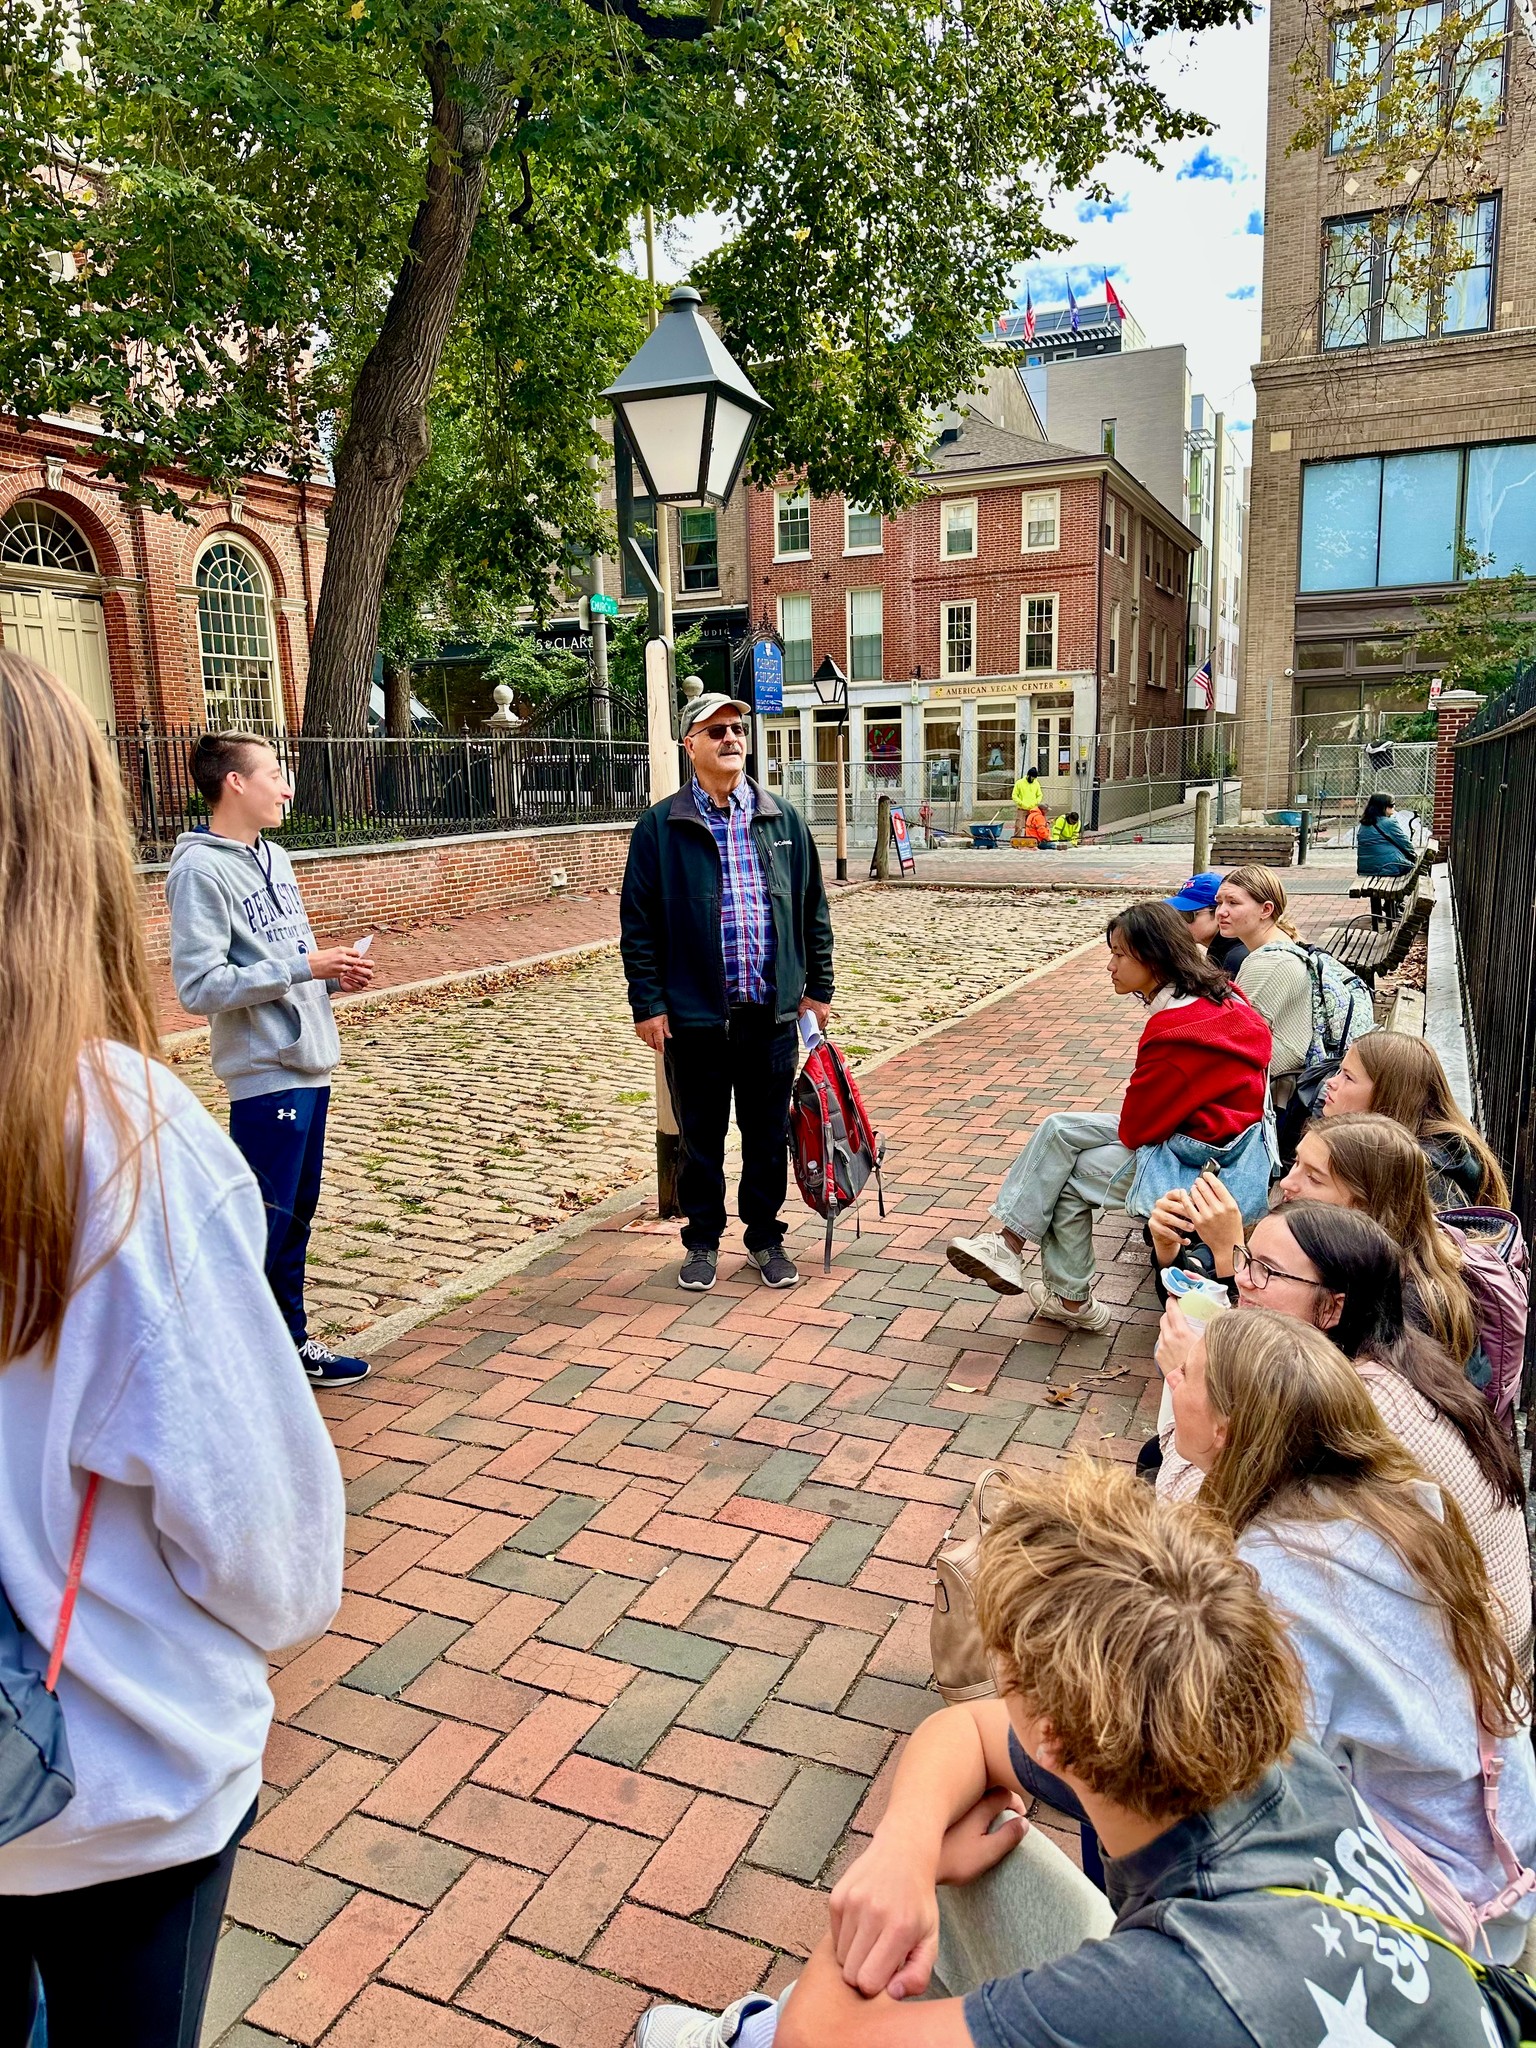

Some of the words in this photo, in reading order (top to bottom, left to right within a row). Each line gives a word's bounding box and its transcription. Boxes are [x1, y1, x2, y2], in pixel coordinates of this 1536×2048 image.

[591, 600, 611, 612] CHURCH
[755, 671, 781, 684] CHURCH
[946, 686, 987, 695] AMERICAN
[990, 684, 1018, 693] VEGAN
[1021, 682, 1054, 690] CENTER
